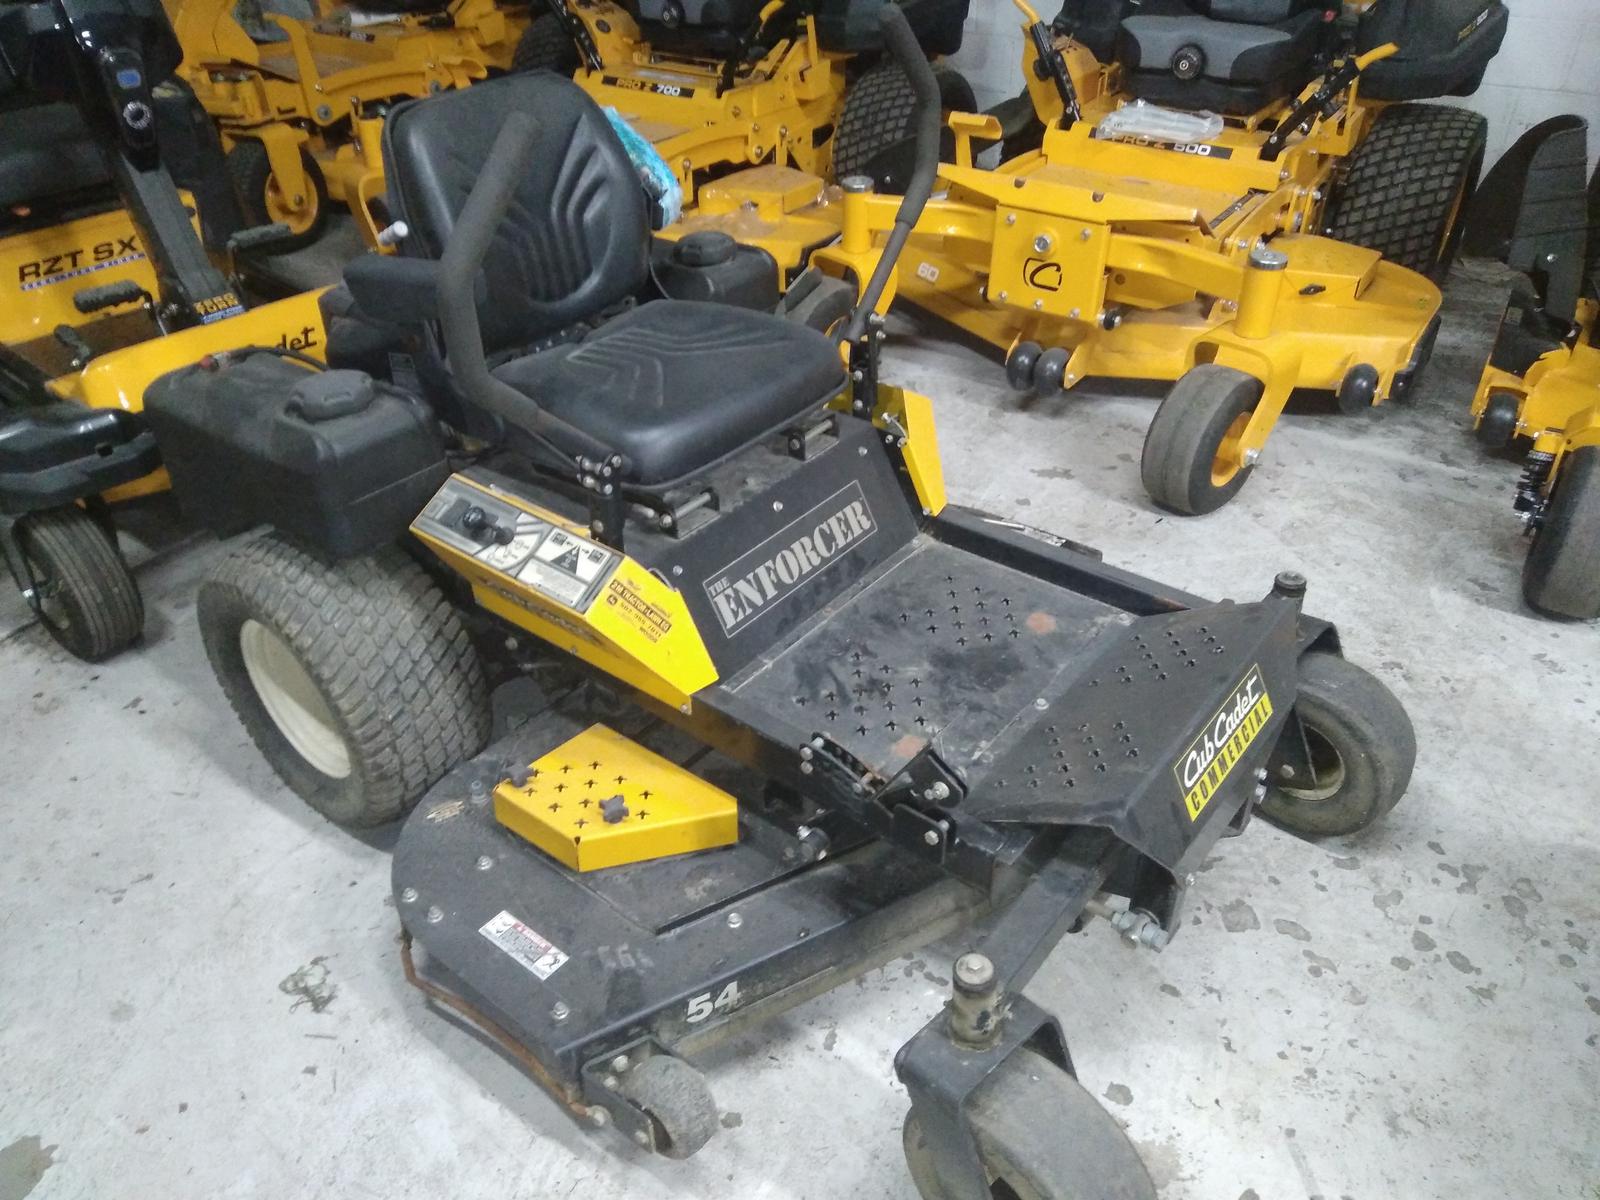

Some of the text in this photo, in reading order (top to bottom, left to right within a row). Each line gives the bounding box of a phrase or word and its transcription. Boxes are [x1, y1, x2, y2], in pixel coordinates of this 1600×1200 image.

[656, 84, 681, 96] 700
[19, 249, 84, 282] RZT
[94, 236, 137, 261] SX
[274, 326, 317, 351] det
[708, 576, 730, 596] THE
[713, 501, 871, 629] ENFORCER
[1184, 675, 1261, 788] Cub Cadet
[1191, 701, 1268, 812] COMMERCIAL
[686, 980, 741, 1023] 54
